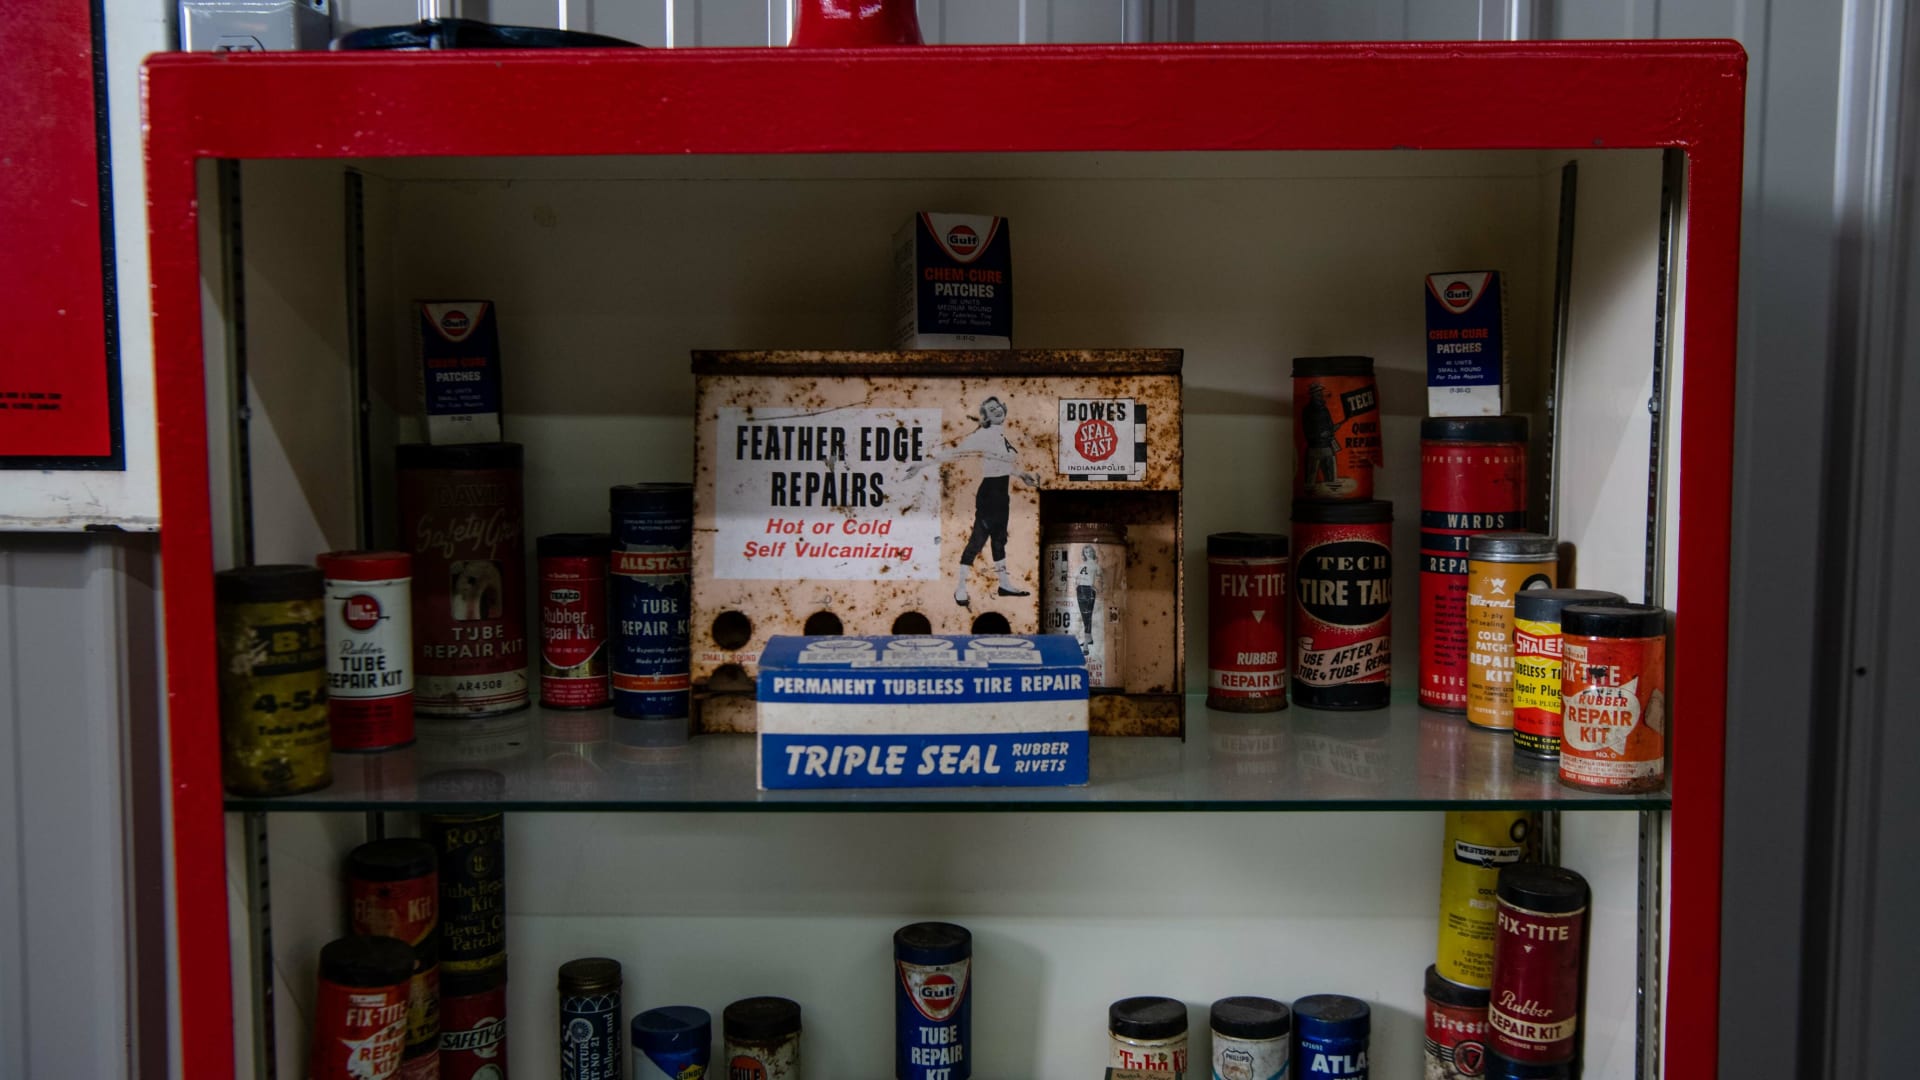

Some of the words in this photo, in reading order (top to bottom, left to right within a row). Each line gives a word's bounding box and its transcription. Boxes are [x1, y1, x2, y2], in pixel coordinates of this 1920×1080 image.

[949, 234, 977, 245] Gulf
[935, 283, 995, 298] PATCHES
[1446, 289, 1471, 299] Gulf
[1436, 342, 1483, 354] PATCHES
[435, 371, 481, 382] PATCHES
[1067, 402, 1126, 421] BOWES
[1080, 423, 1112, 441] SEAL
[736, 425, 846, 462] FEATHER
[860, 426, 924, 462] EDGE
[1084, 439, 1113, 457] FAST
[771, 471, 885, 508] REPAIRS
[765, 518, 805, 535] Hot
[812, 521, 835, 535] or
[842, 519, 893, 536] Cold
[1447, 514, 1505, 530] WARDS
[415, 512, 484, 560] Safety
[743, 541, 787, 558] Self
[795, 542, 914, 562] Vulcanizing
[620, 556, 687, 572] ALLSTAT
[1317, 554, 1387, 572] TECH
[1429, 556, 1468, 574] REPA
[1220, 572, 1286, 598] FIX-TITE
[1300, 579, 1350, 607] TIRE
[551, 591, 581, 600] TEXACO
[543, 605, 588, 625] Rubber
[641, 599, 679, 615] TUBE
[452, 624, 505, 641] TUBE
[544, 624, 574, 645] epair
[576, 623, 597, 640] Kit
[621, 619, 670, 636] REPAIR
[1478, 630, 1505, 642] COLD
[340, 639, 386, 656] Rubber
[423, 641, 495, 660] REPAIR
[500, 637, 525, 656] KIT
[1303, 653, 1325, 666] USE
[1331, 642, 1373, 665] AFTER
[1475, 641, 1508, 653] PATCH
[340, 655, 386, 672] TUBE
[1237, 651, 1278, 666] RUBBER
[381, 669, 403, 687] KIT
[1300, 665, 1318, 681] TIRE
[1329, 662, 1360, 681] TUBE
[1485, 669, 1513, 683] KIT
[1551, 668, 1561, 681] TI
[456, 679, 503, 692] AR4508
[773, 677, 876, 696] PERMANENT
[882, 678, 964, 696] TUBELESS
[973, 676, 1013, 694] TIRE
[1021, 673, 1082, 693] REPAIR
[1221, 674, 1270, 688] REPAIR
[1578, 694, 1629, 708] RUBBER
[1568, 704, 1633, 727] REPAIR
[1579, 727, 1611, 745] KIT
[1011, 742, 1069, 757] RUBBER
[785, 744, 908, 778] TRIPLE
[916, 744, 1001, 775] SEAL
[1014, 758, 1066, 774] RIVETS
[1458, 843, 1496, 856] WESTERN
[1499, 849, 1519, 857] AUTO
[407, 895, 433, 923] Kit
[444, 919, 486, 938] Bevel
[1498, 911, 1569, 942] FIX-TITE
[452, 930, 501, 952] Patch
[921, 985, 956, 999] Gulf
[1499, 989, 1553, 1018] Rubber
[345, 1000, 410, 1028] FIX-TITE
[1432, 1010, 1491, 1034] Firest
[1491, 1009, 1536, 1040] REPAIR
[1539, 1025, 1562, 1040] KIT
[919, 1024, 958, 1045] TUBE
[911, 1044, 963, 1066] REPAIR
[1225, 1053, 1250, 1063] PHILLIPS
[1310, 1050, 1368, 1074] ATLA
[925, 1067, 951, 1080] KIT
